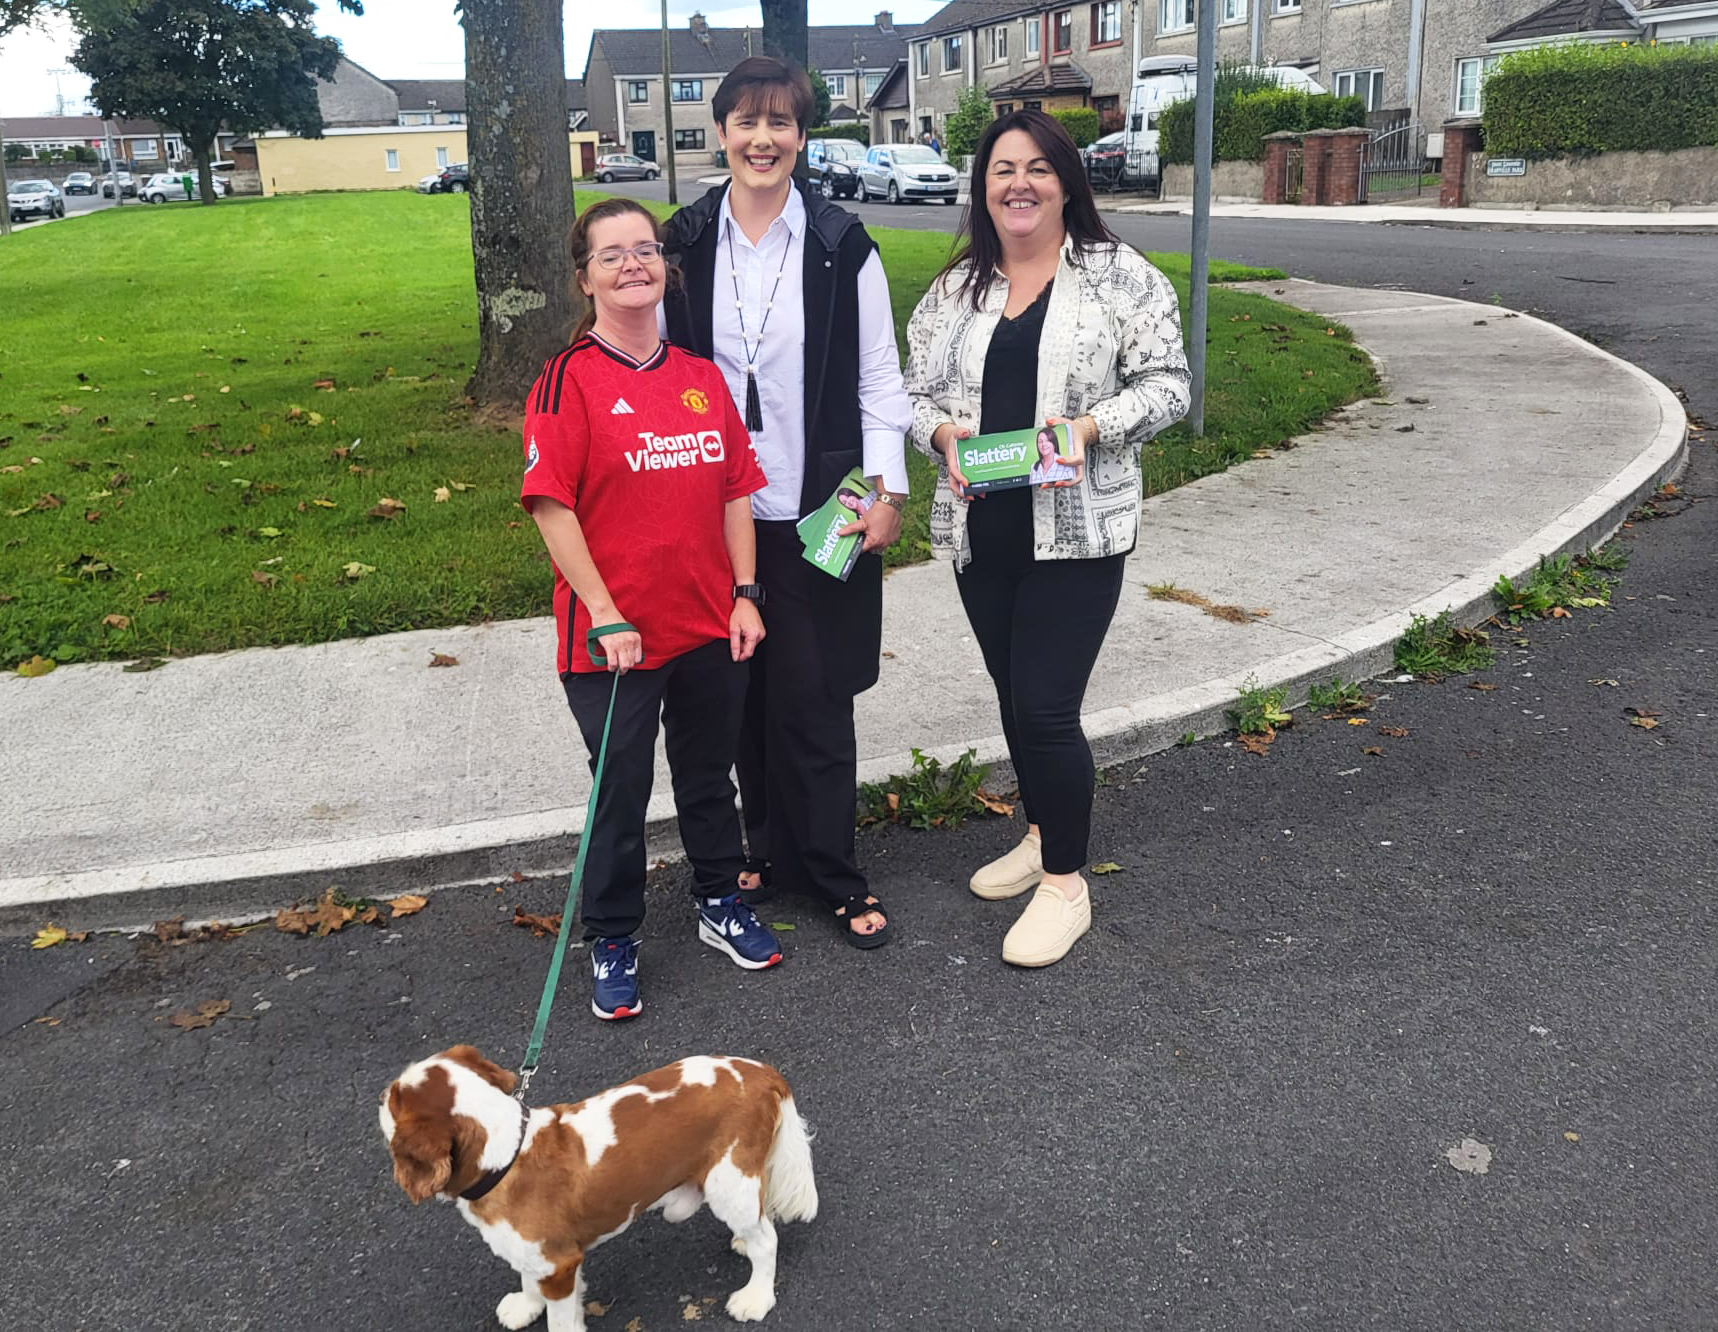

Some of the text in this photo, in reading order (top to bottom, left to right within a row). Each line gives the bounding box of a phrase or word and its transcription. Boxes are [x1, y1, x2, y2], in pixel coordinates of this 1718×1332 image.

[638, 432, 697, 452] Team
[624, 449, 699, 472] Viewer
[964, 446, 1027, 467] Slattery
